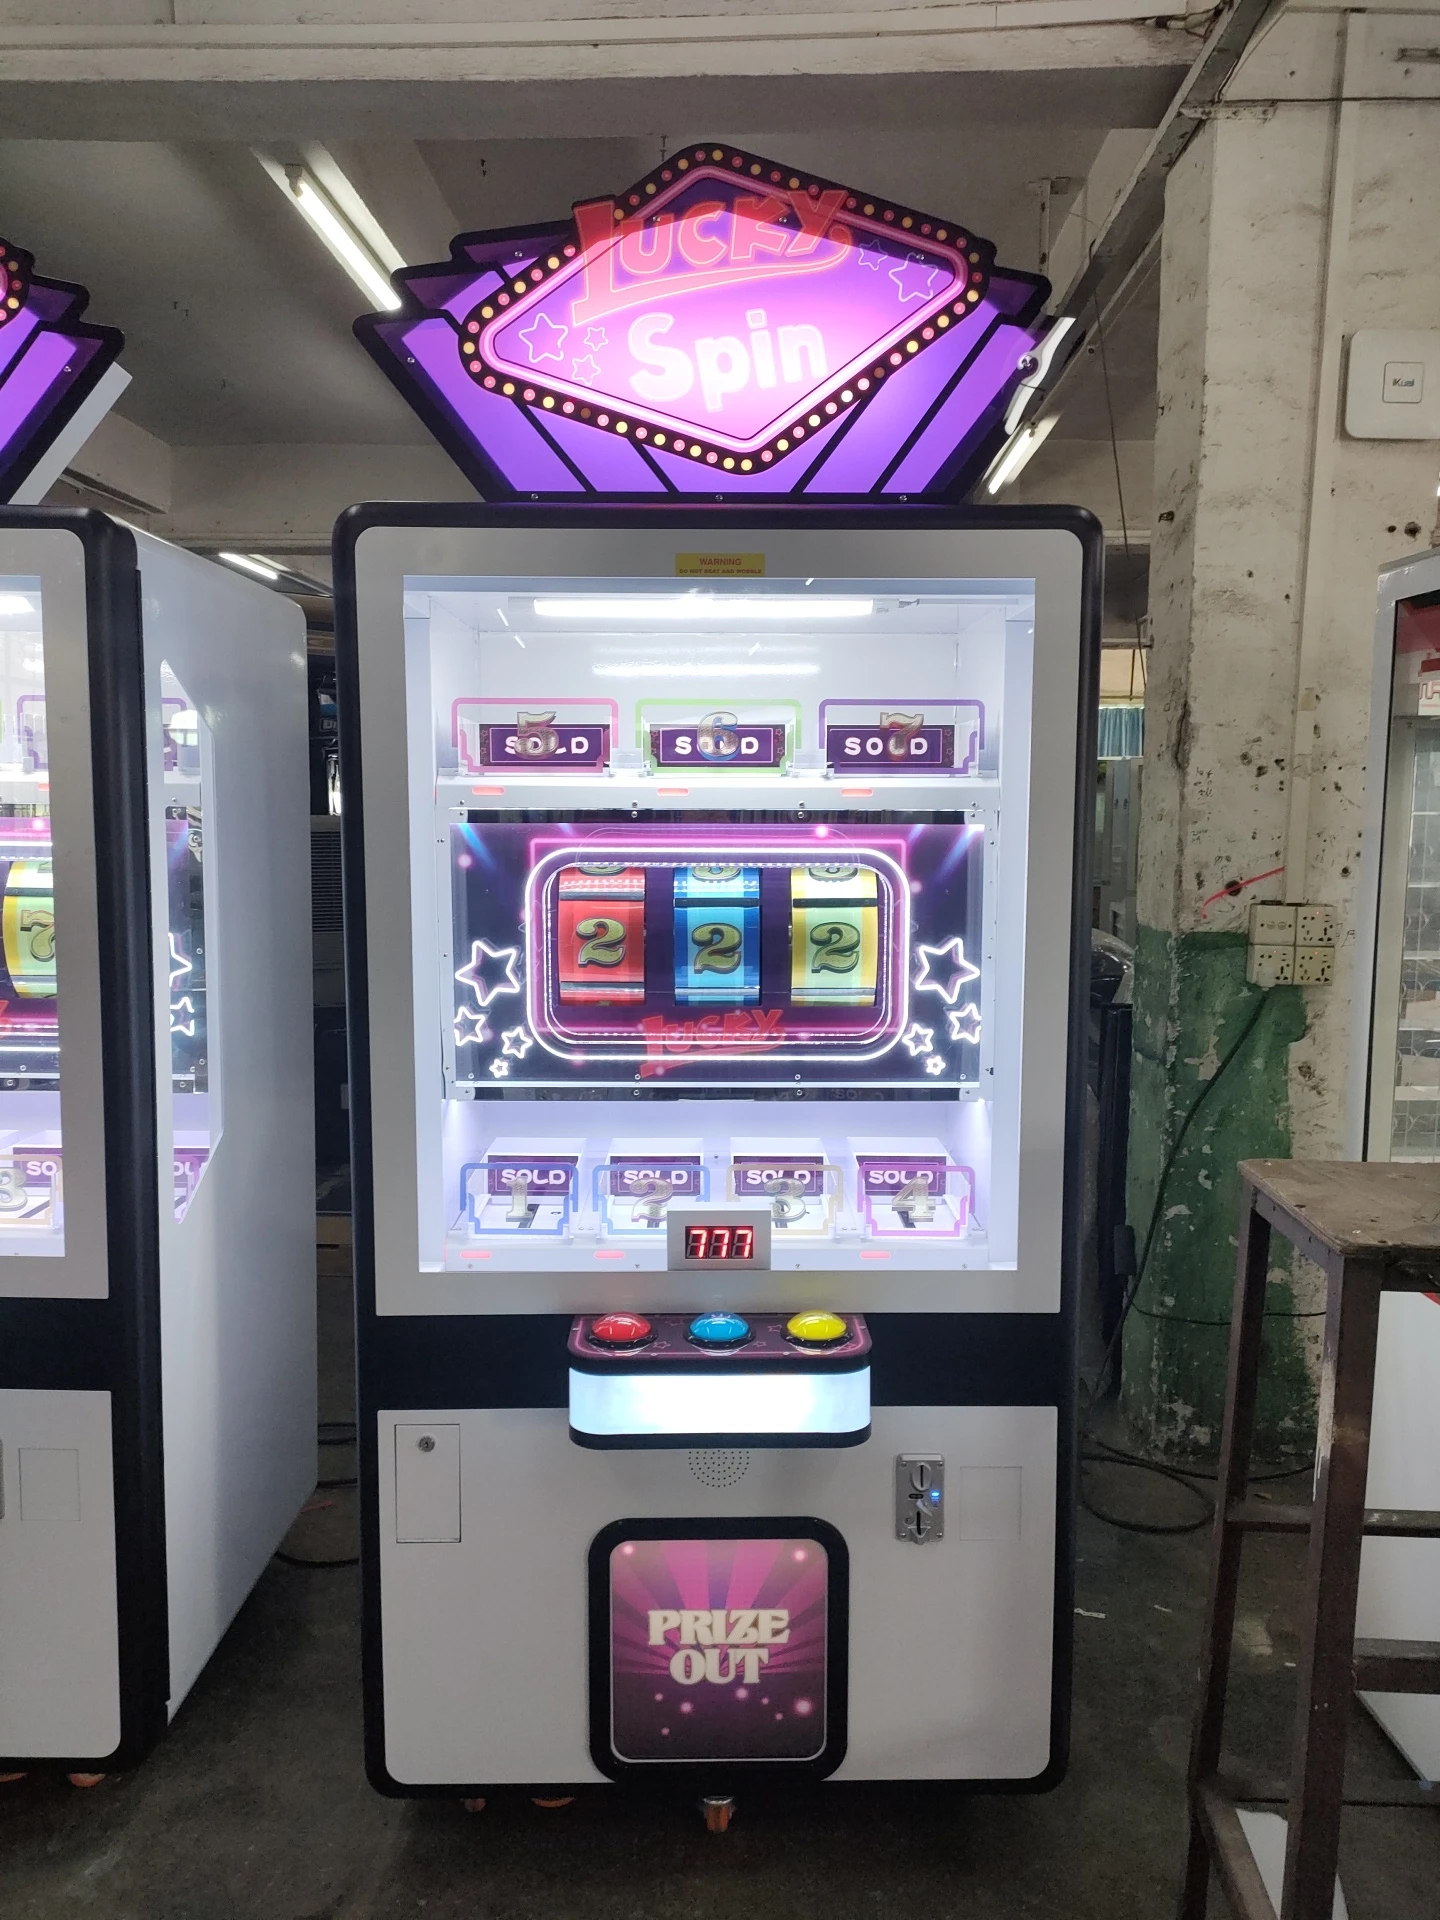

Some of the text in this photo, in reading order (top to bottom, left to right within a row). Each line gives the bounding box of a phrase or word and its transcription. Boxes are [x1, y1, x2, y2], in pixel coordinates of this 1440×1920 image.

[627, 308, 829, 414] Spin
[699, 557, 742, 566] WARNING
[515, 711, 560, 760] 5
[674, 736, 759, 755] SD
[697, 711, 740, 762] 6
[844, 737, 928, 756] SOD
[879, 711, 924, 760] 7
[576, 917, 627, 968] 2
[692, 922, 742, 974] 2
[810, 921, 861, 974] 2
[501, 1169, 567, 1185] SOLD
[506, 1176, 535, 1222] 1
[629, 1177, 674, 1222] 2
[763, 1177, 806, 1222] 3
[868, 1170, 934, 1185] SOLD
[892, 1173, 936, 1222] 4
[690, 1229, 753, 1259] 777
[648, 1609, 791, 1646] PRIZE
[669, 1648, 769, 1685] OUT
